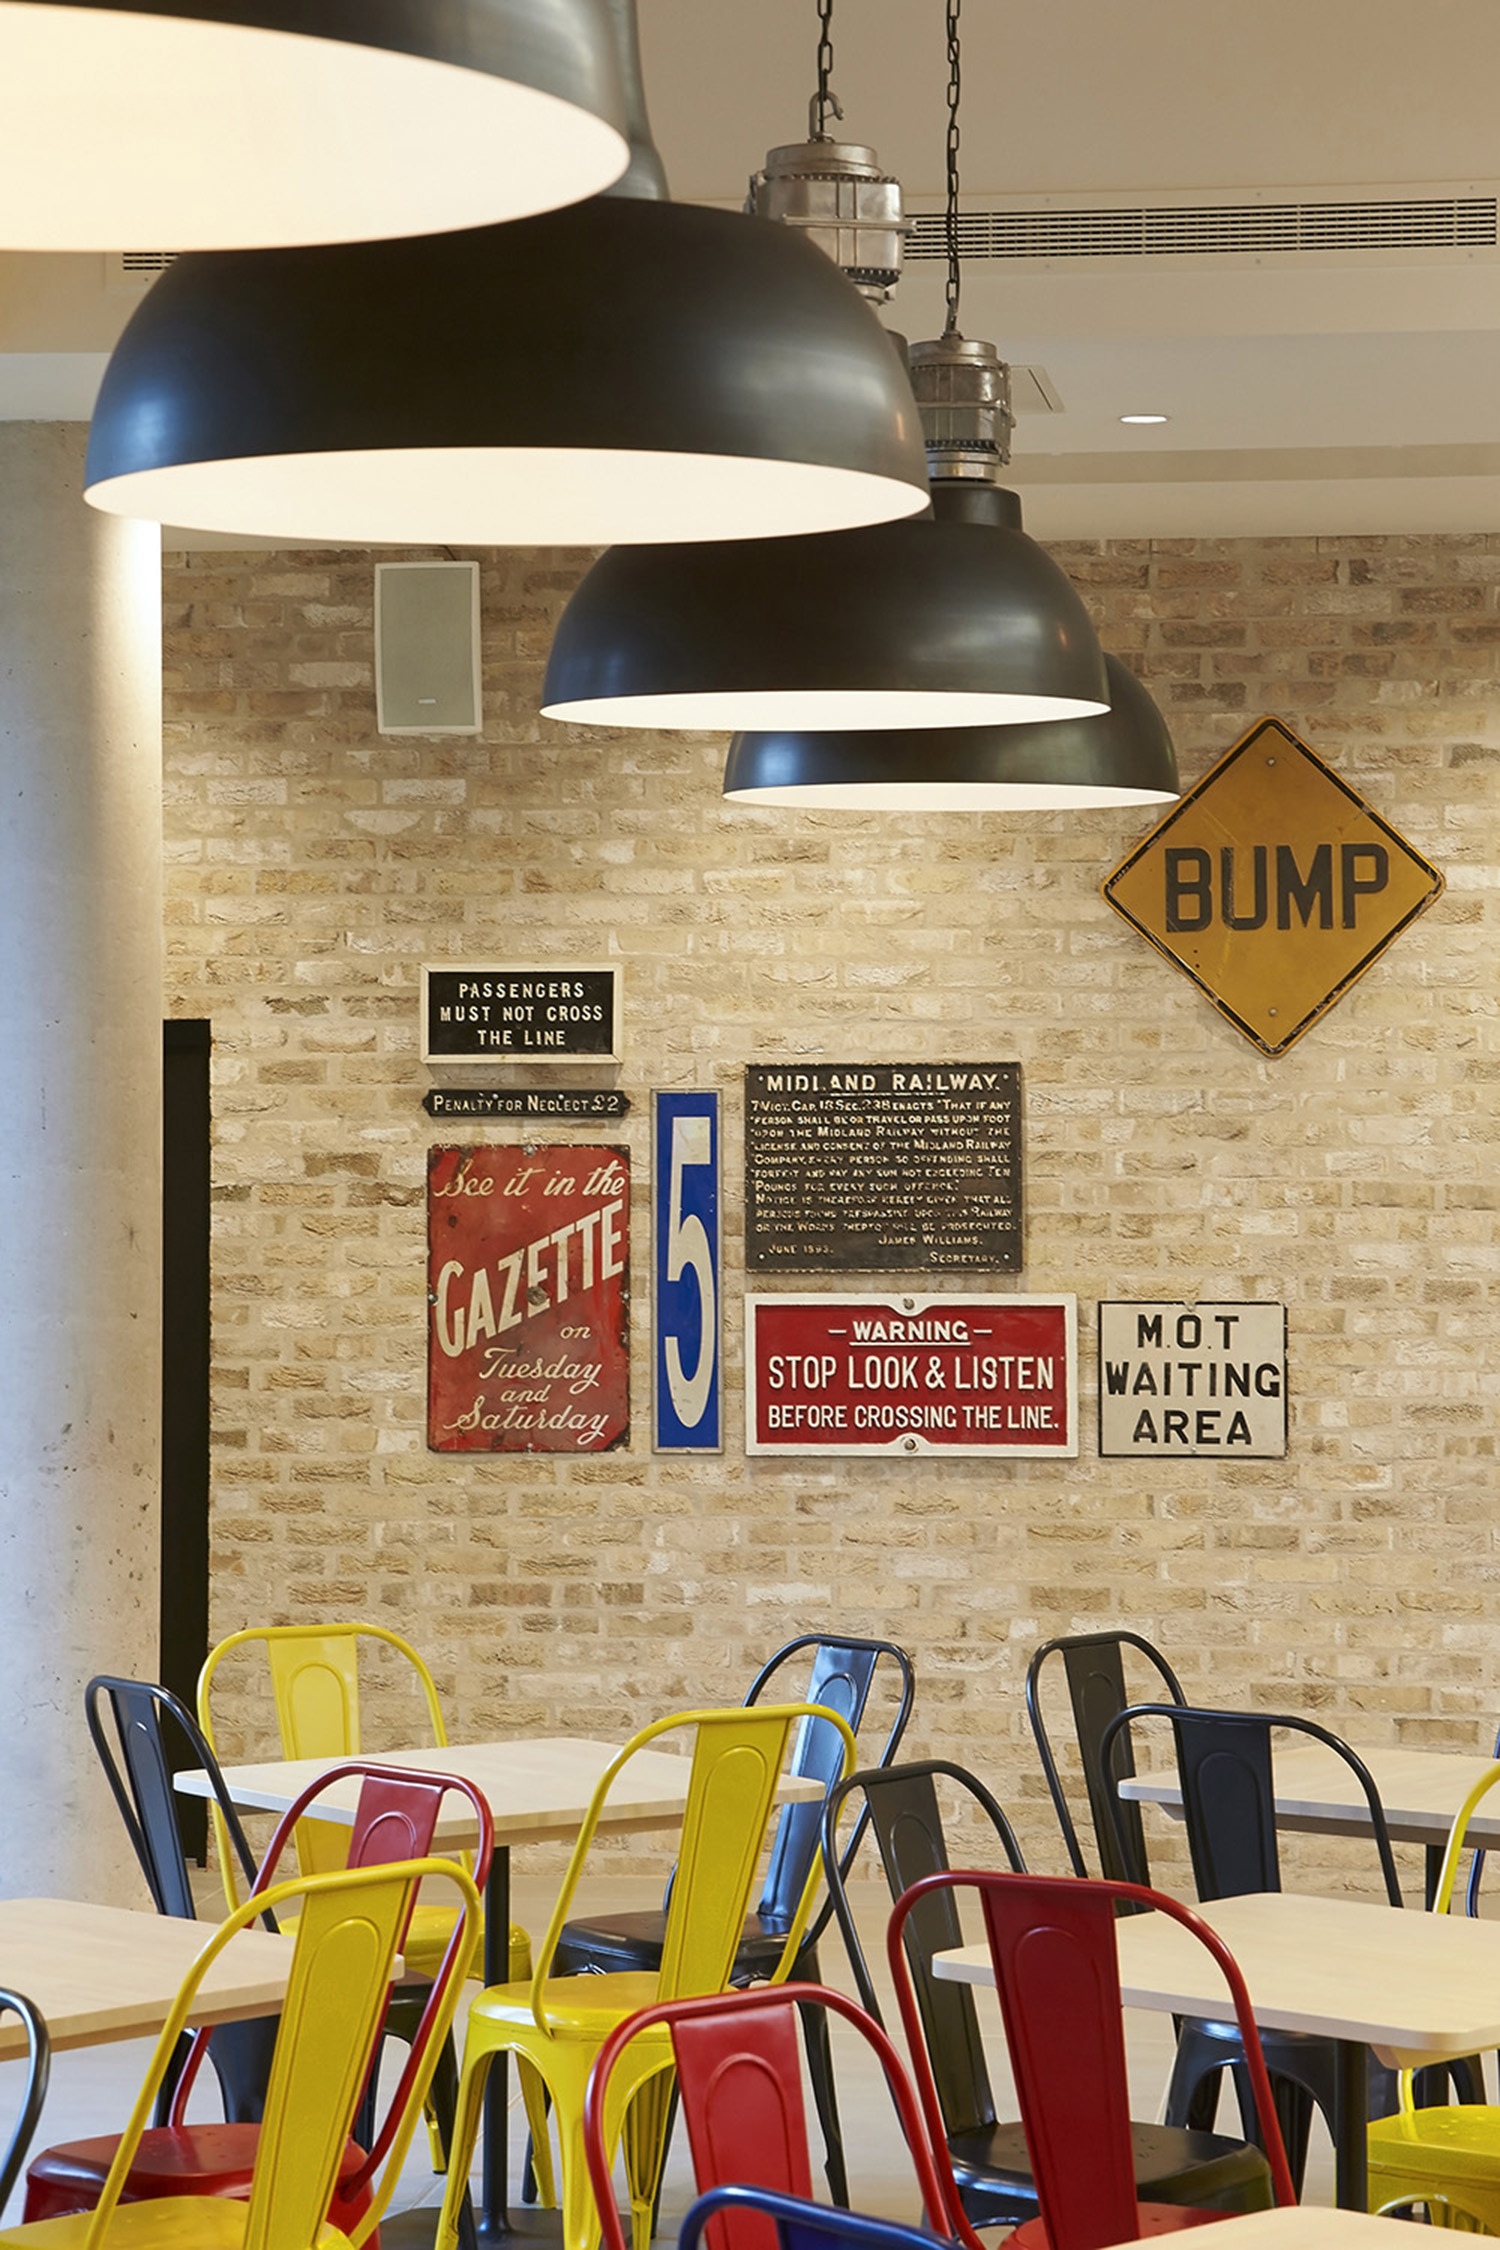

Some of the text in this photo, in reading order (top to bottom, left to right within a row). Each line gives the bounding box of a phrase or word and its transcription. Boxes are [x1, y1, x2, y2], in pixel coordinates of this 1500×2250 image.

[1164, 842, 1389, 933] BUMP
[458, 982, 585, 999] PASSENGERS
[440, 1005, 603, 1021] MUST NOT CROSS
[477, 1029, 566, 1046] THE LINE
[767, 1074, 877, 1092] MIDLAND
[591, 1094, 619, 1112] £2
[989, 1101, 1012, 1110] ANY
[433, 1158, 626, 1198] See it in the
[435, 1199, 624, 1358] GAZETTE
[664, 1116, 714, 1429] 5
[560, 1324, 592, 1340] on
[852, 1320, 970, 1342] WARNING
[478, 1346, 603, 1396] Tuesday
[768, 1355, 1055, 1391] STOP LOOK & LISTEN
[1104, 1360, 1281, 1398] WAITING
[500, 1383, 553, 1403] and
[443, 1394, 610, 1446] Saturday
[767, 1404, 1060, 1430] BEFORE CROSSING THE LINE.
[1132, 1408, 1253, 1445] AREA
